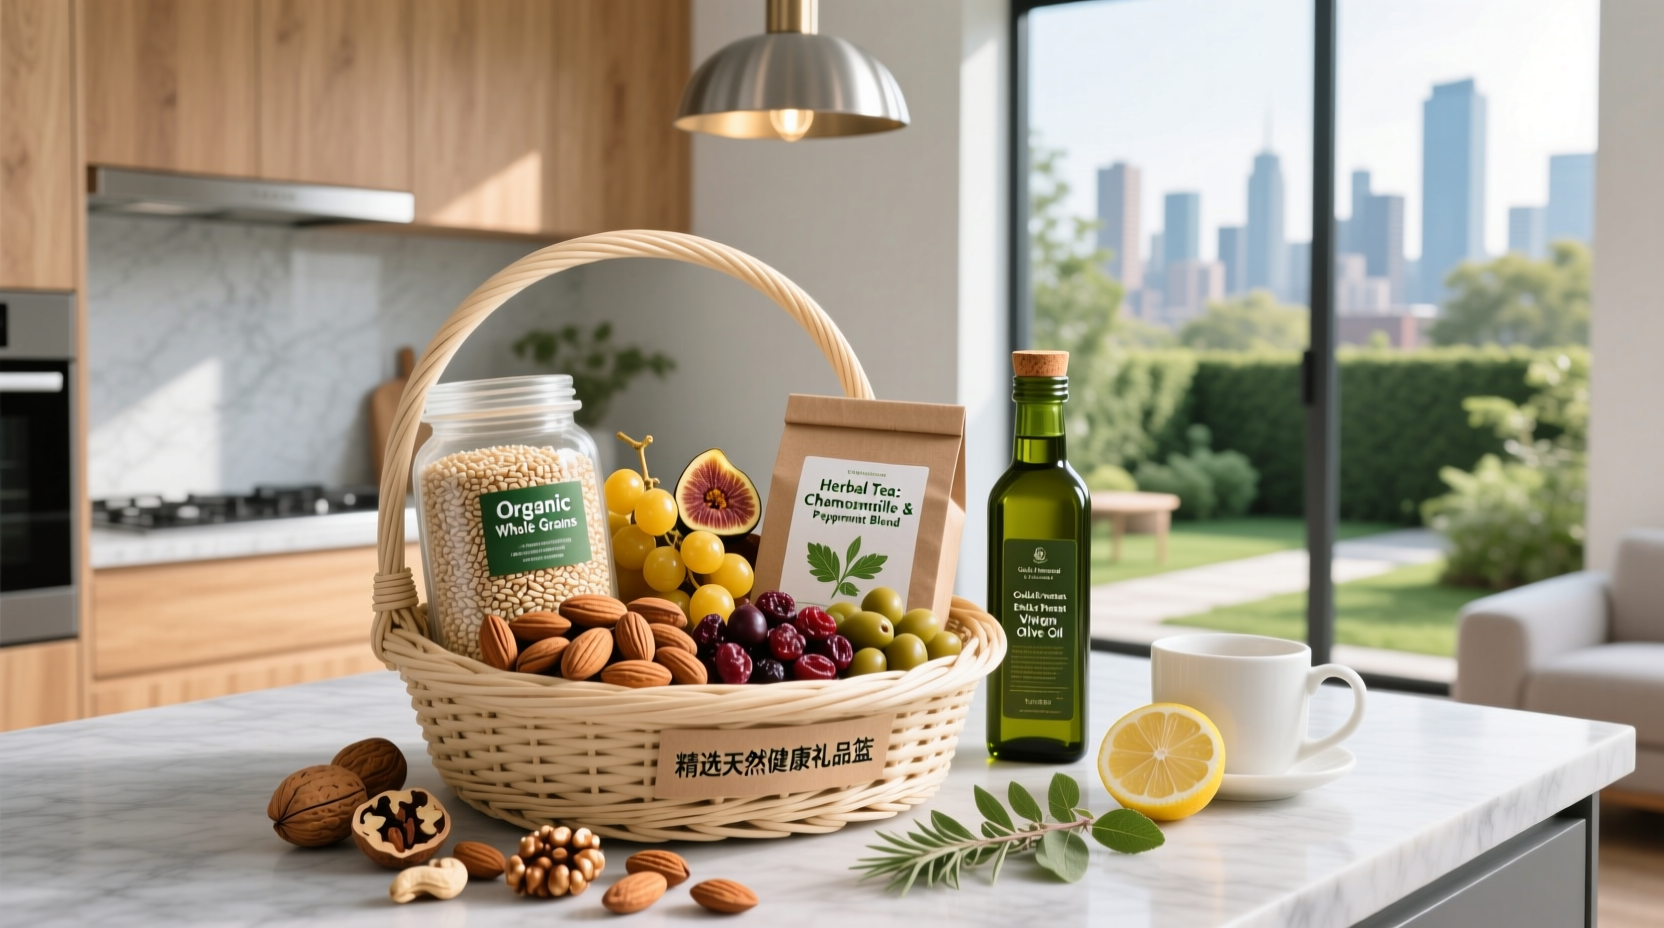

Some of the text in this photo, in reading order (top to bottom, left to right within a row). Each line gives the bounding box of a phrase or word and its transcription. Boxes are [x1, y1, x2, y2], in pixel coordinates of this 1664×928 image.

[820, 478, 902, 498] Herbal Tea:
[496, 493, 571, 520] Organic
[902, 502, 914, 515] &
[495, 517, 578, 539] Whole Grains
[869, 514, 901, 527] Blend
[674, 736, 875, 779] 精选天然健康礼品篮
